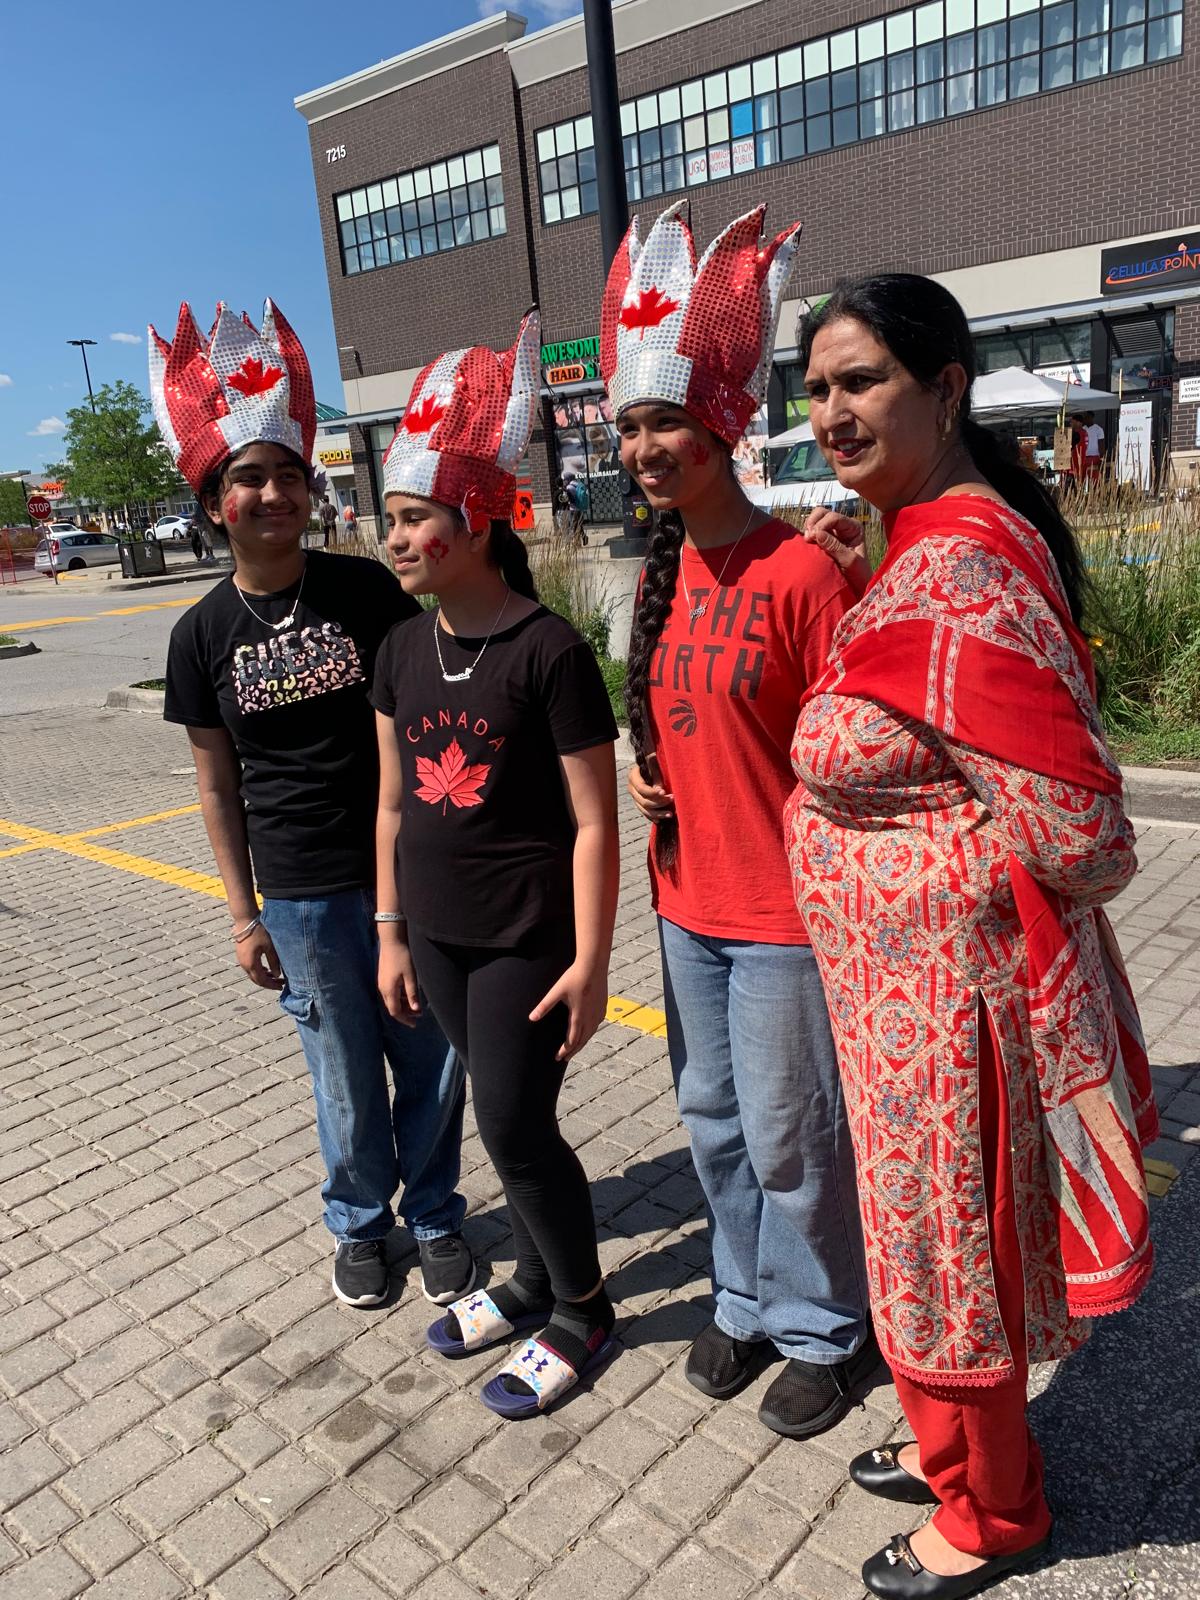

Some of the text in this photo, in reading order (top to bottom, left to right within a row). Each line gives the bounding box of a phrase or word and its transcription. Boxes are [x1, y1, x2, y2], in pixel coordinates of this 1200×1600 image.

[326, 144, 347, 164] 7215
[551, 367, 582, 383] HAIR
[318, 450, 342, 461] FOOD
[29, 502, 50, 513] STOP
[689, 587, 774, 644] THE
[234, 622, 349, 686] GUESS
[648, 641, 766, 701] ORTH
[406, 709, 506, 752] CANADA
